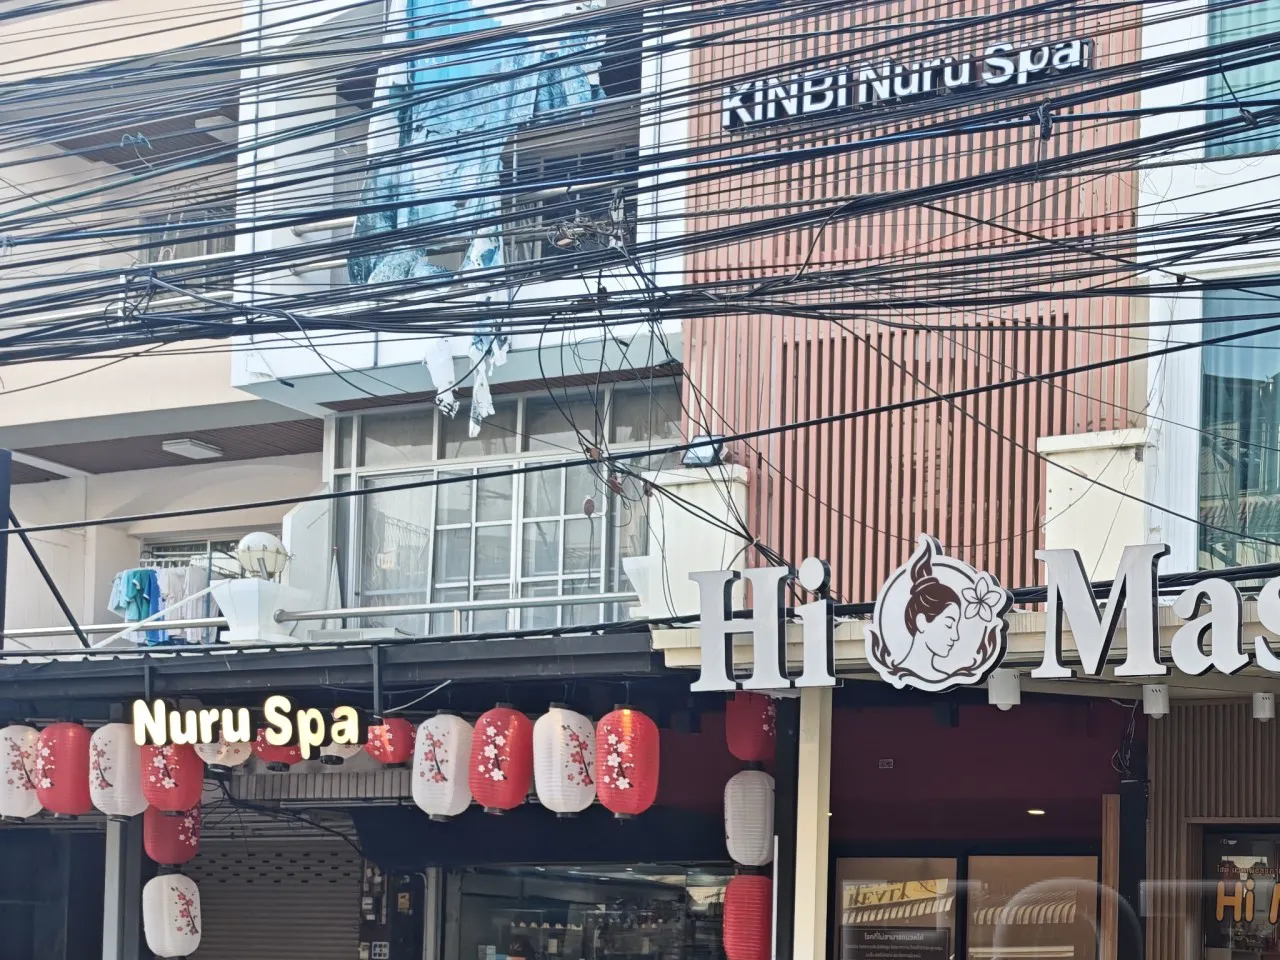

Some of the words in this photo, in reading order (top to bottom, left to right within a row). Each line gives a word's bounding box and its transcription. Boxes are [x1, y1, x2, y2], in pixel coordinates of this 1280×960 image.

[722, 67, 851, 127] KINBI
[858, 54, 971, 103] Nuru
[981, 39, 1086, 85] Spa
[688, 557, 840, 693] Hi
[132, 698, 250, 746] Nuru
[263, 694, 359, 760] Spa
[1215, 878, 1256, 922] Hi
